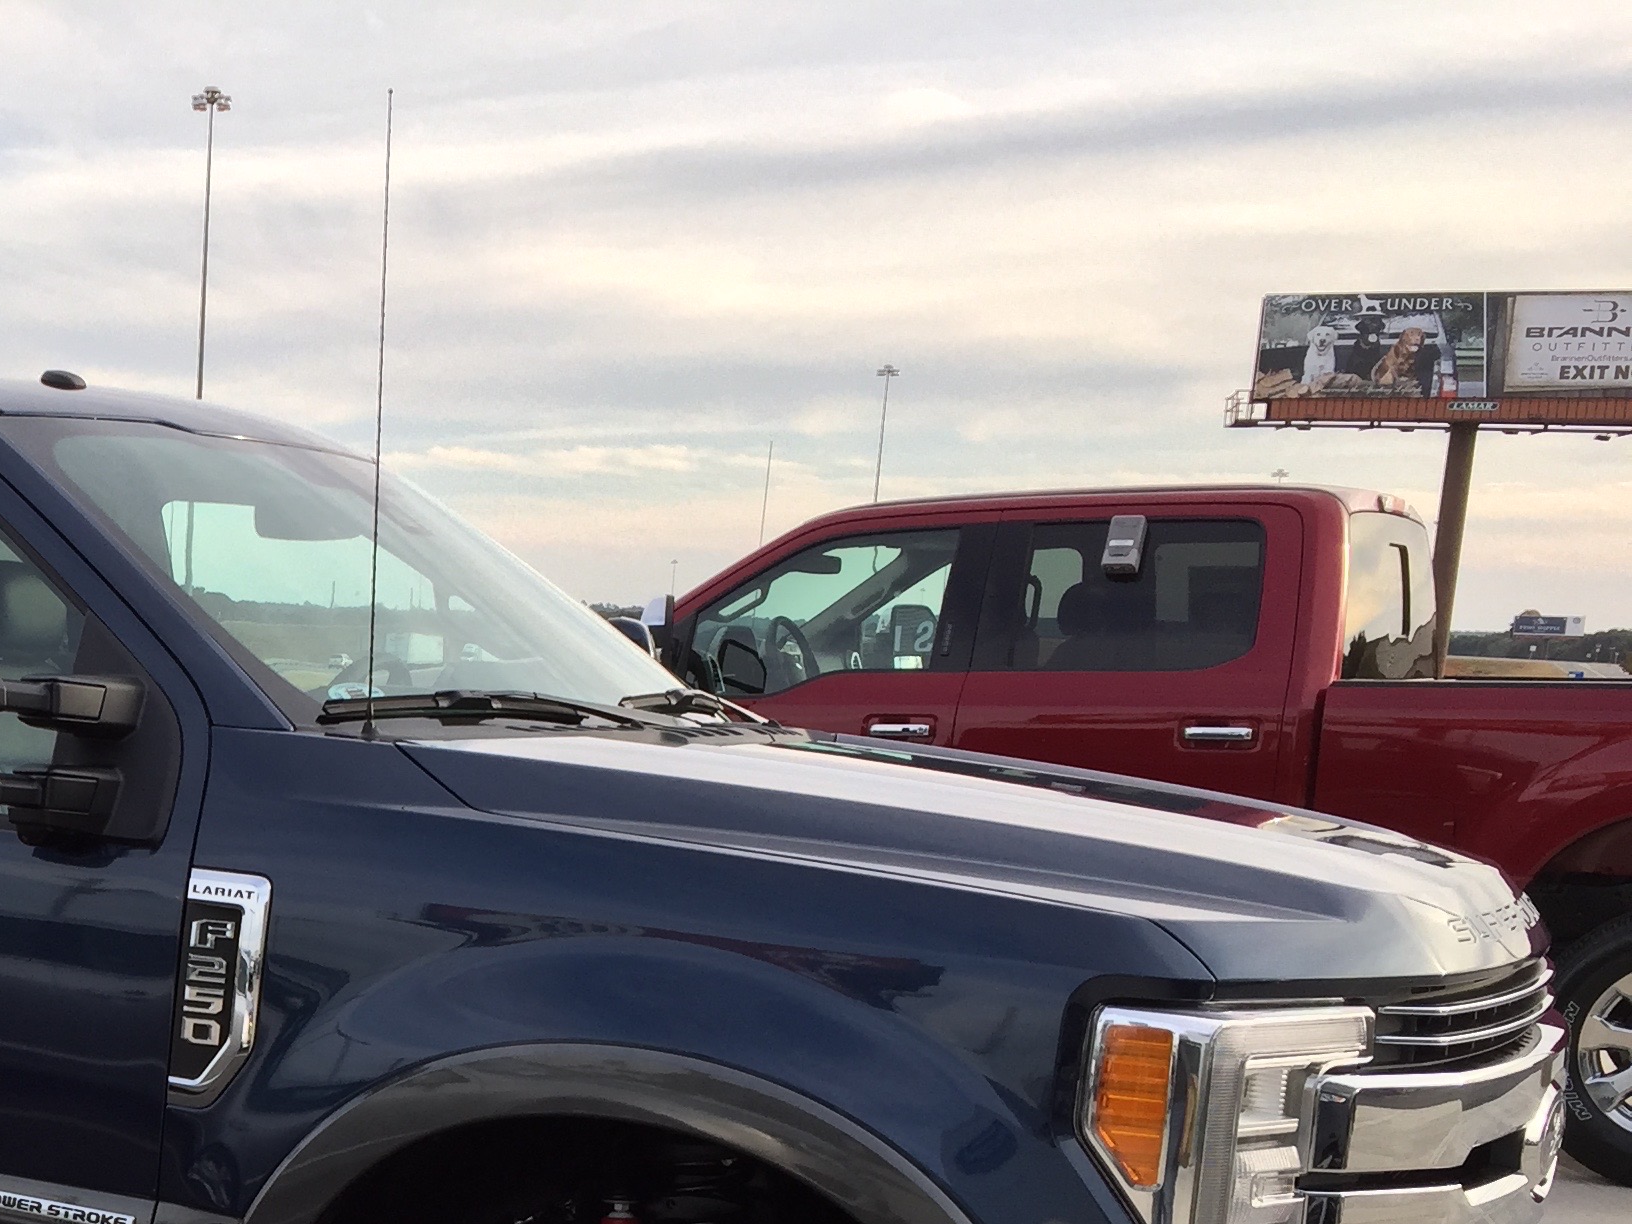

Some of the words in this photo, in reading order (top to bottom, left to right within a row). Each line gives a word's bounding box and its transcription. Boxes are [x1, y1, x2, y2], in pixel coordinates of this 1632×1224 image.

[1301, 299, 1353, 312] OVER
[1386, 297, 1454, 311] UNDER
[1532, 342, 1632, 352] OUTFITT
[1559, 364, 1610, 380] EXIT
[1614, 364, 1632, 380] N
[1453, 402, 1494, 410] LAMAR
[192, 884, 256, 900] LARIAT
